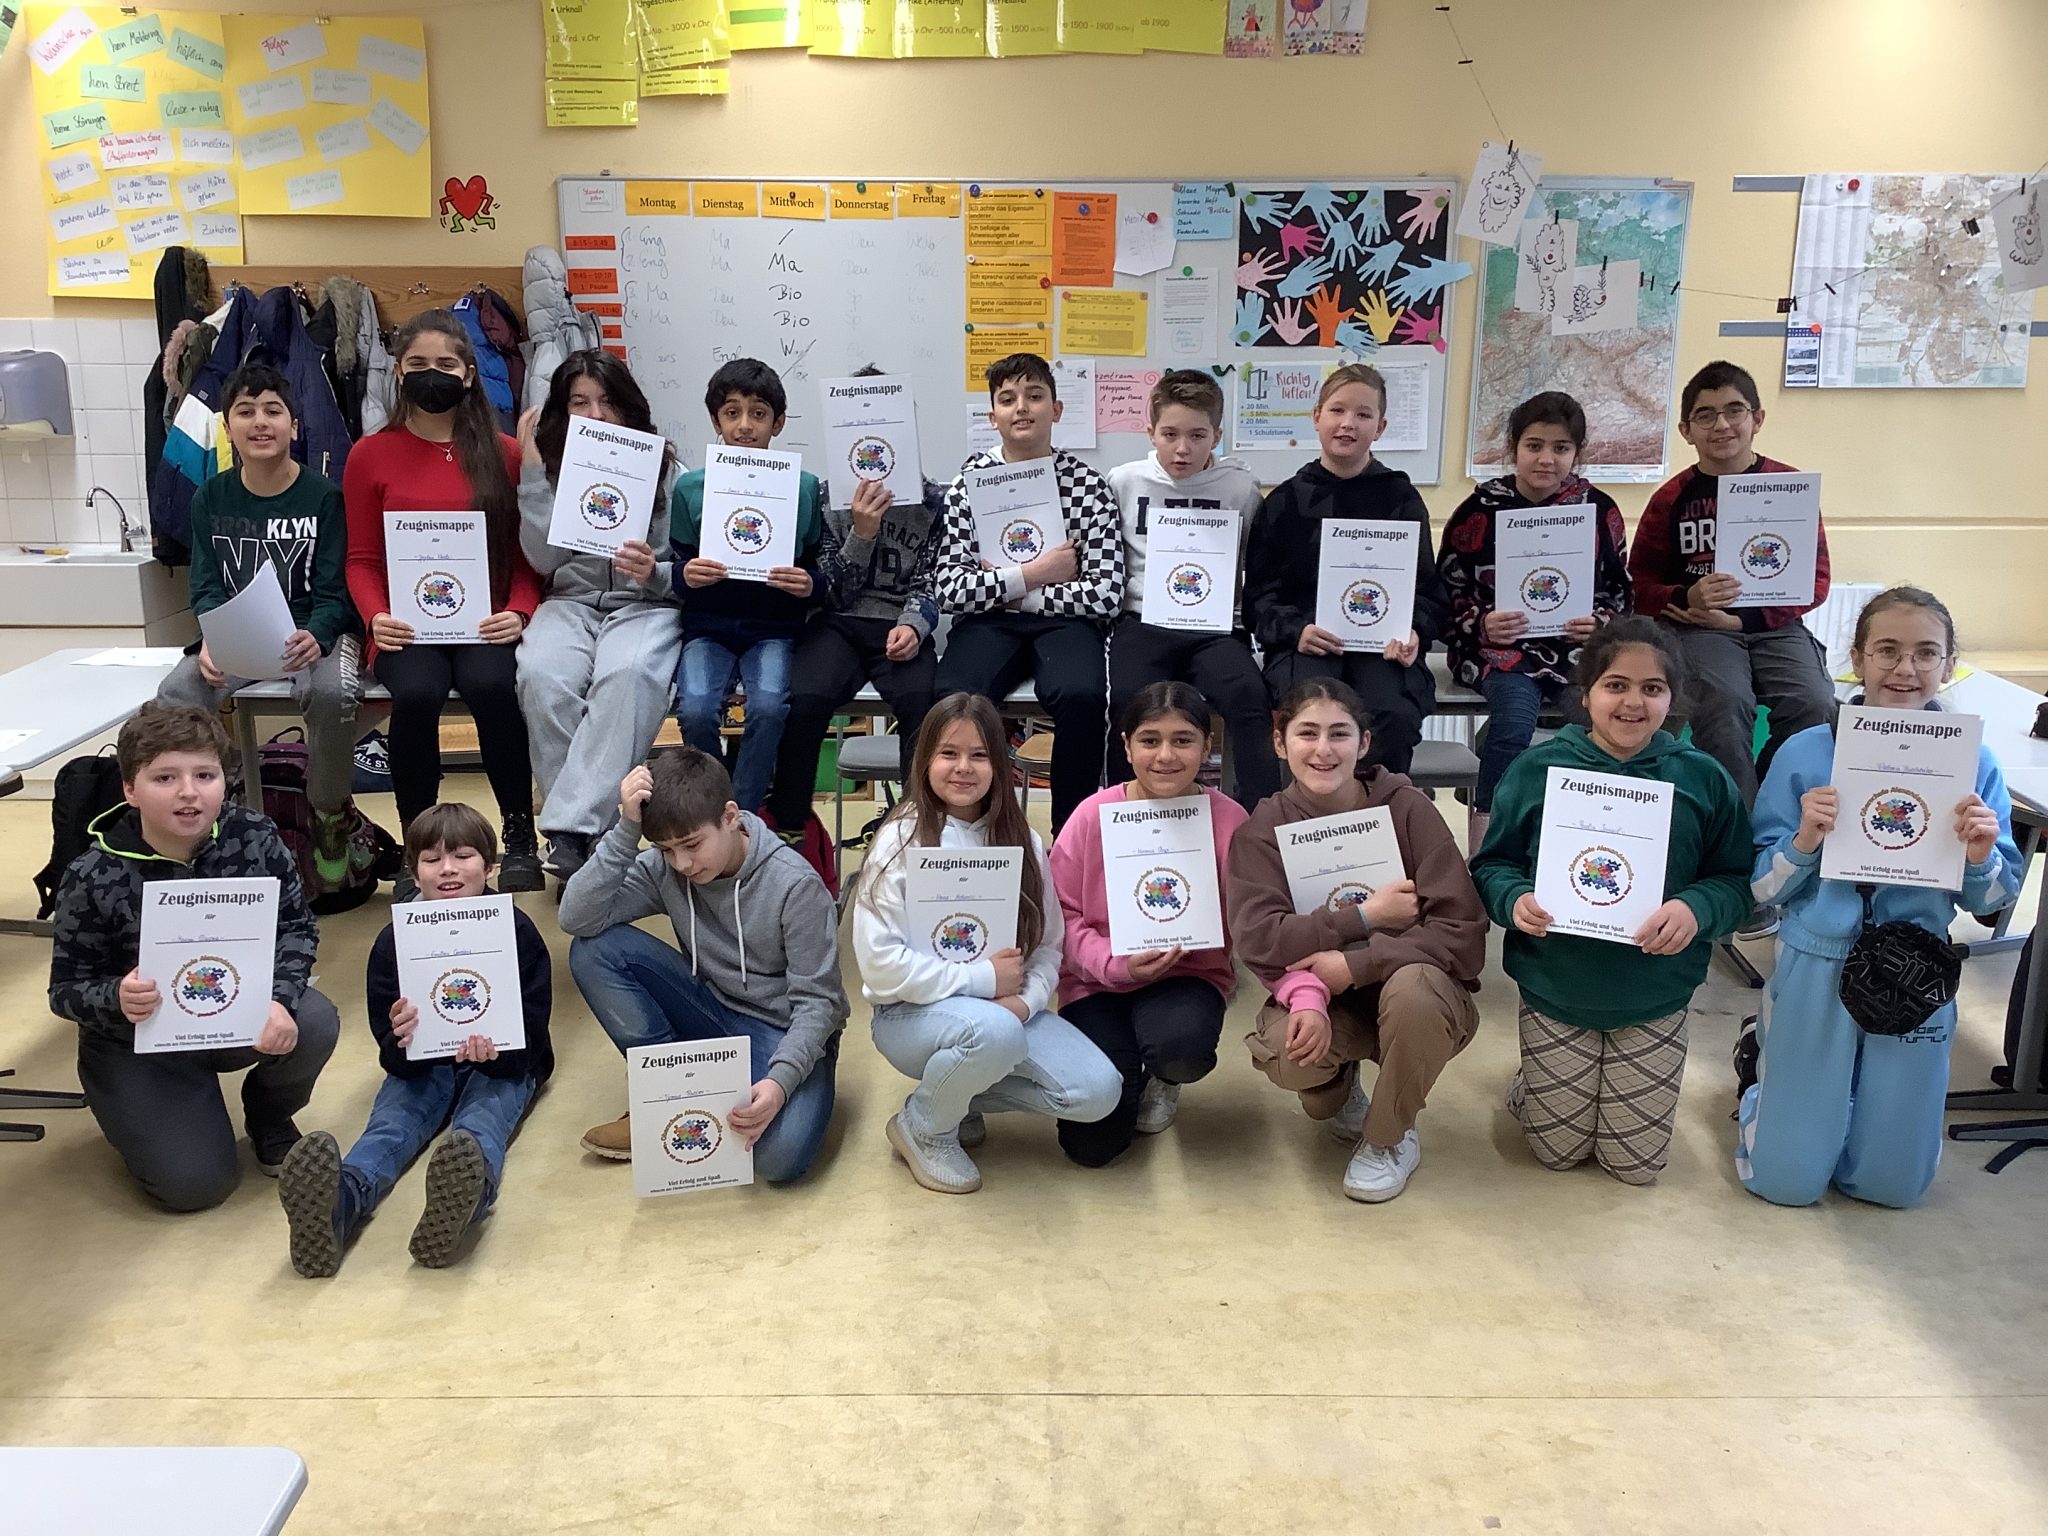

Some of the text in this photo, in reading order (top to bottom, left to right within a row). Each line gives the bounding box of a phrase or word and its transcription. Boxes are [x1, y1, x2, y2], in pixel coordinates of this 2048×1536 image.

[1152, 19, 1169, 27] 1900
[639, 197, 677, 210] Montag
[702, 199, 744, 211] Dienstag
[769, 196, 814, 209] Mittwoch
[834, 199, 889, 211] Donnerstag
[912, 193, 946, 205] Freitag
[768, 251, 804, 274] Ma
[768, 283, 802, 302] Bio
[773, 310, 811, 329] Bio
[1276, 371, 1311, 387] Richtig
[830, 385, 902, 398] Zeugnismappe
[579, 425, 654, 452] Zeugnismappe
[716, 453, 791, 471] Zeugnismappe
[976, 467, 1045, 488] Zeugnismappe
[1729, 482, 1810, 495] Zeugnismappe
[396, 520, 475, 532] Zeugnismappe
[1158, 515, 1229, 528] Zeugnismappe
[1507, 515, 1585, 529] Zeugnismappe
[1332, 527, 1408, 541] Zeugnismappe
[1853, 717, 1962, 739] Zeugnismappe
[1561, 778, 1659, 804] Zeugnismappe
[1112, 806, 1199, 824] Zeugnismappe
[1290, 819, 1380, 846] Zeugnismappe
[920, 858, 1010, 871] Zeugnismappe
[158, 891, 265, 907] Zeugnismappe
[406, 907, 500, 925] Zeugnismappe
[641, 1049, 738, 1069] Zeugnismappe
